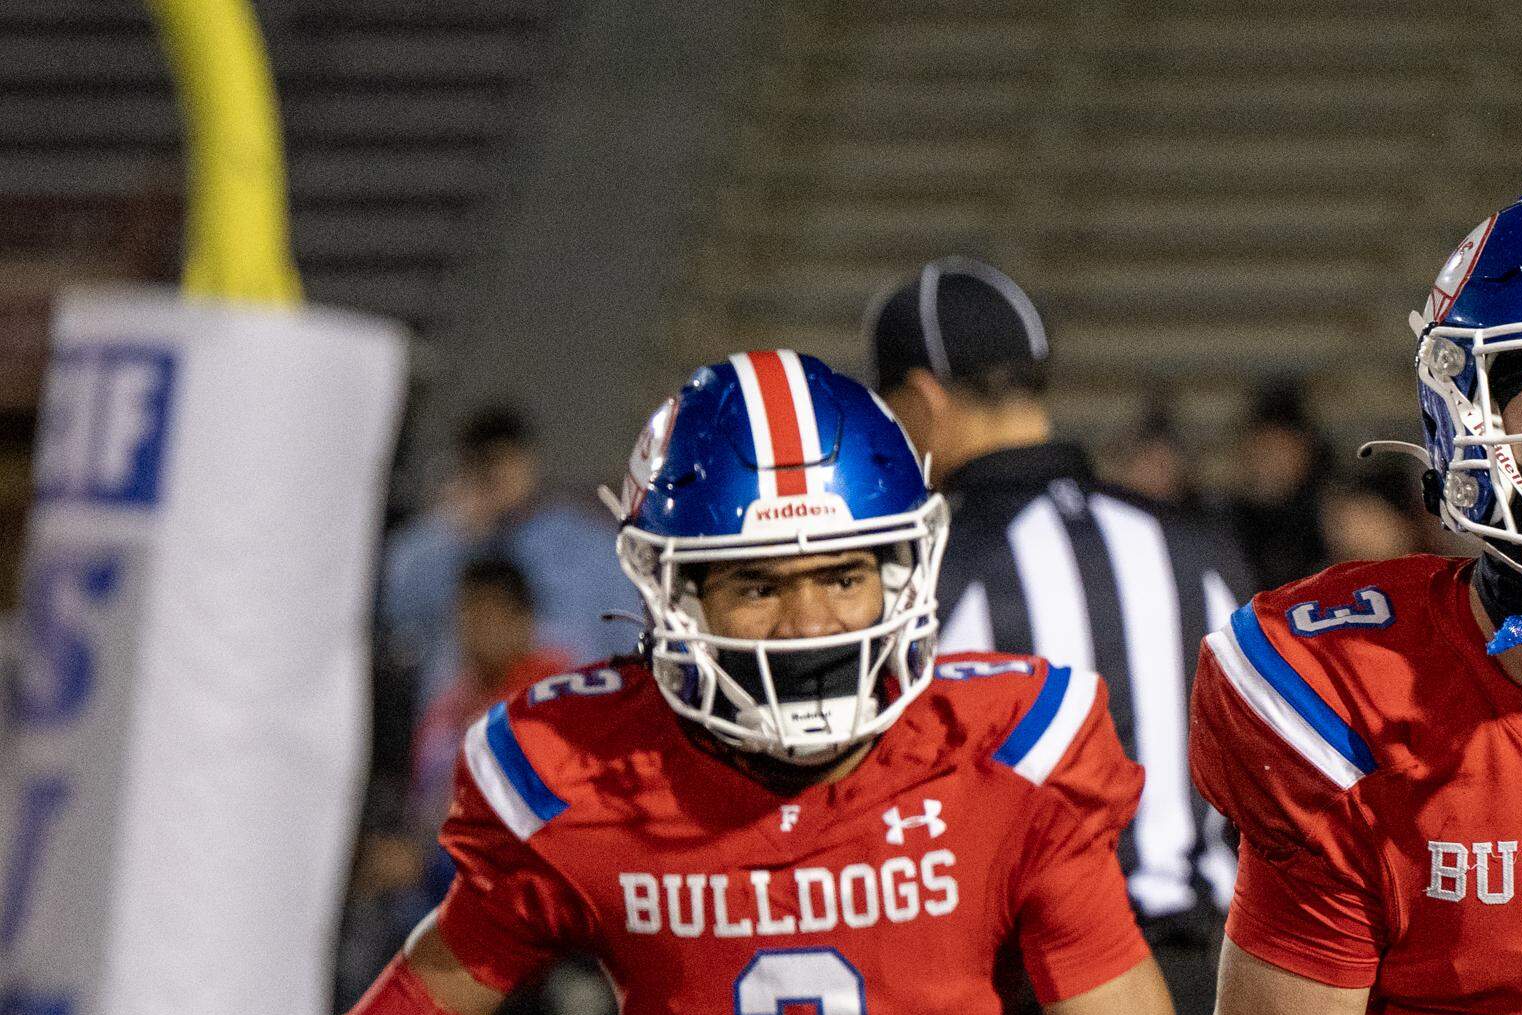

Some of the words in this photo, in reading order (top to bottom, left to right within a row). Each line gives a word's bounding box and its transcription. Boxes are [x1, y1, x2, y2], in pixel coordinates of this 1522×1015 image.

[1285, 585, 1396, 638] 3
[528, 669, 626, 707] 2
[779, 805, 801, 833] F
[618, 849, 960, 938] BULLDOGS
